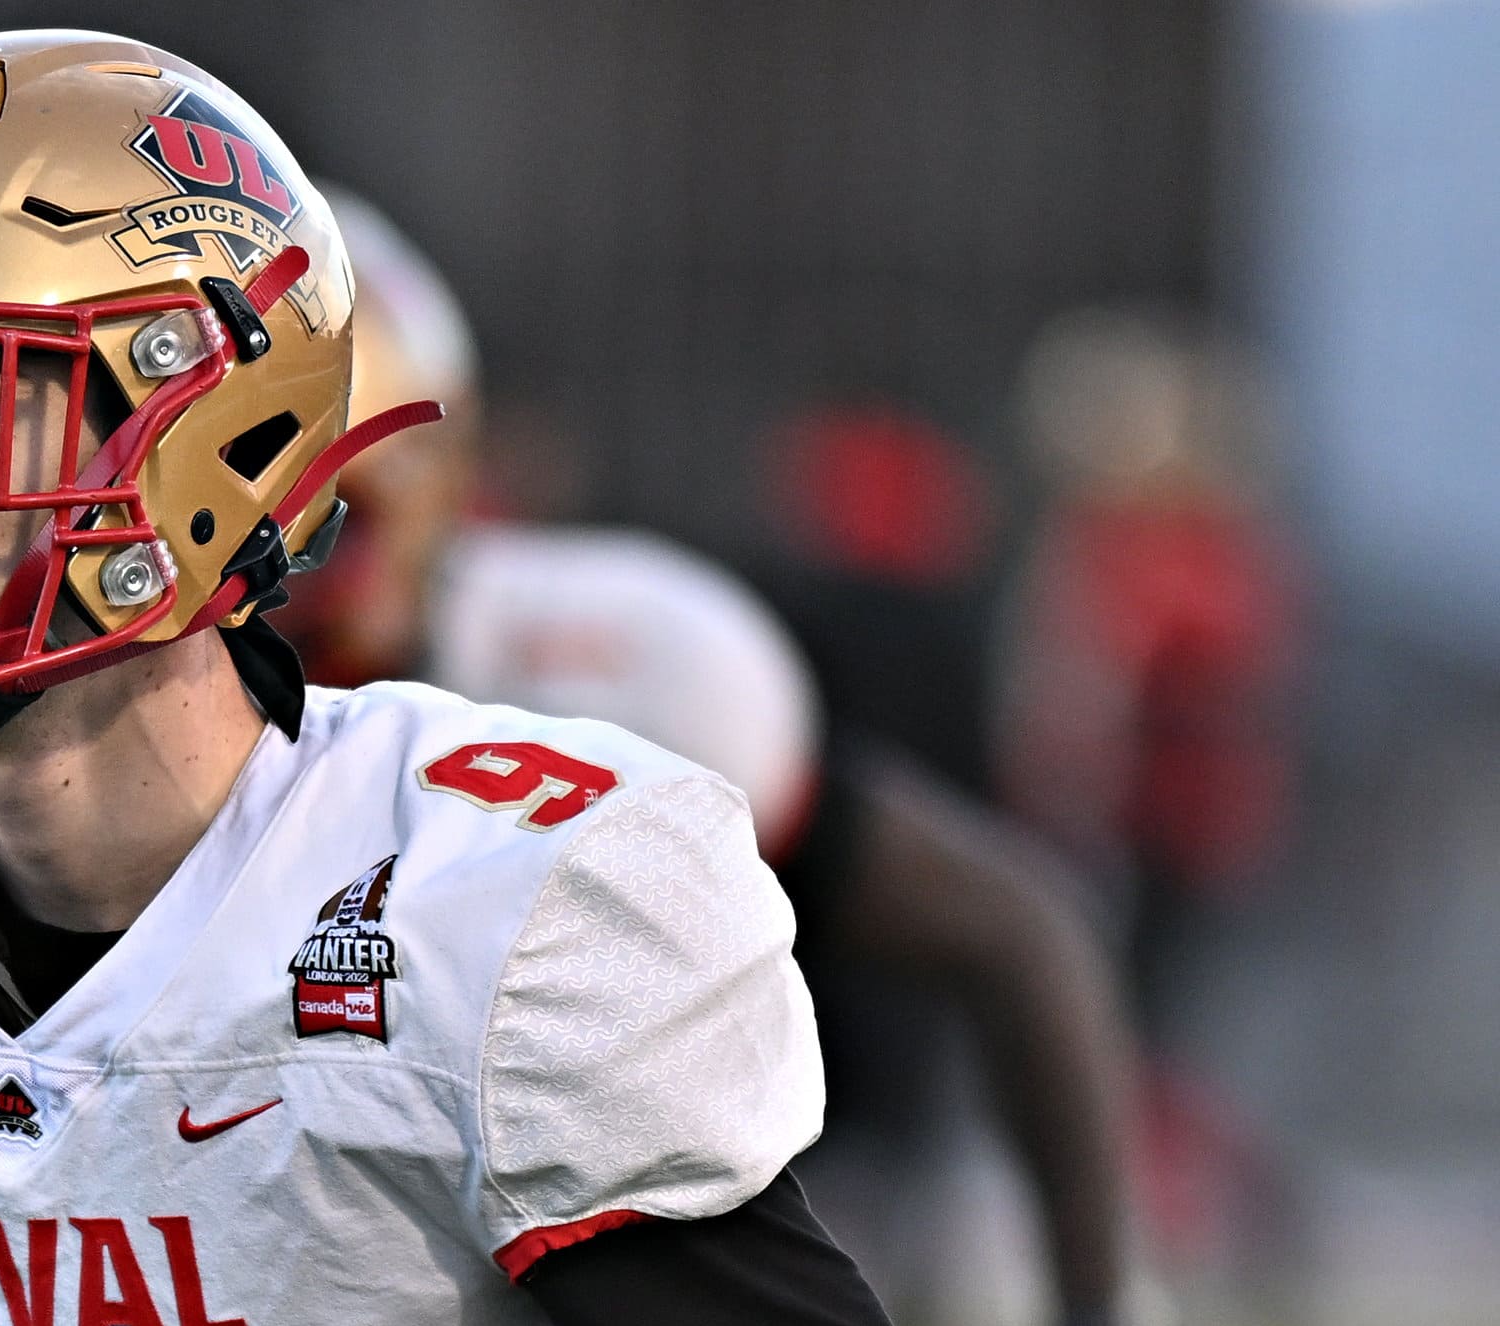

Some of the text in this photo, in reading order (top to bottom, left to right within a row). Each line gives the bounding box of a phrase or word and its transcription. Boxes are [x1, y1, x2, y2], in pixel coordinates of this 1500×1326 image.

[147, 114, 293, 218] UL
[148, 203, 280, 246] ROUGE ET
[415, 740, 627, 833] 9
[293, 937, 390, 973] VANIER
[306, 969, 370, 984] LONDON 2022
[298, 999, 375, 1015] canada vie
